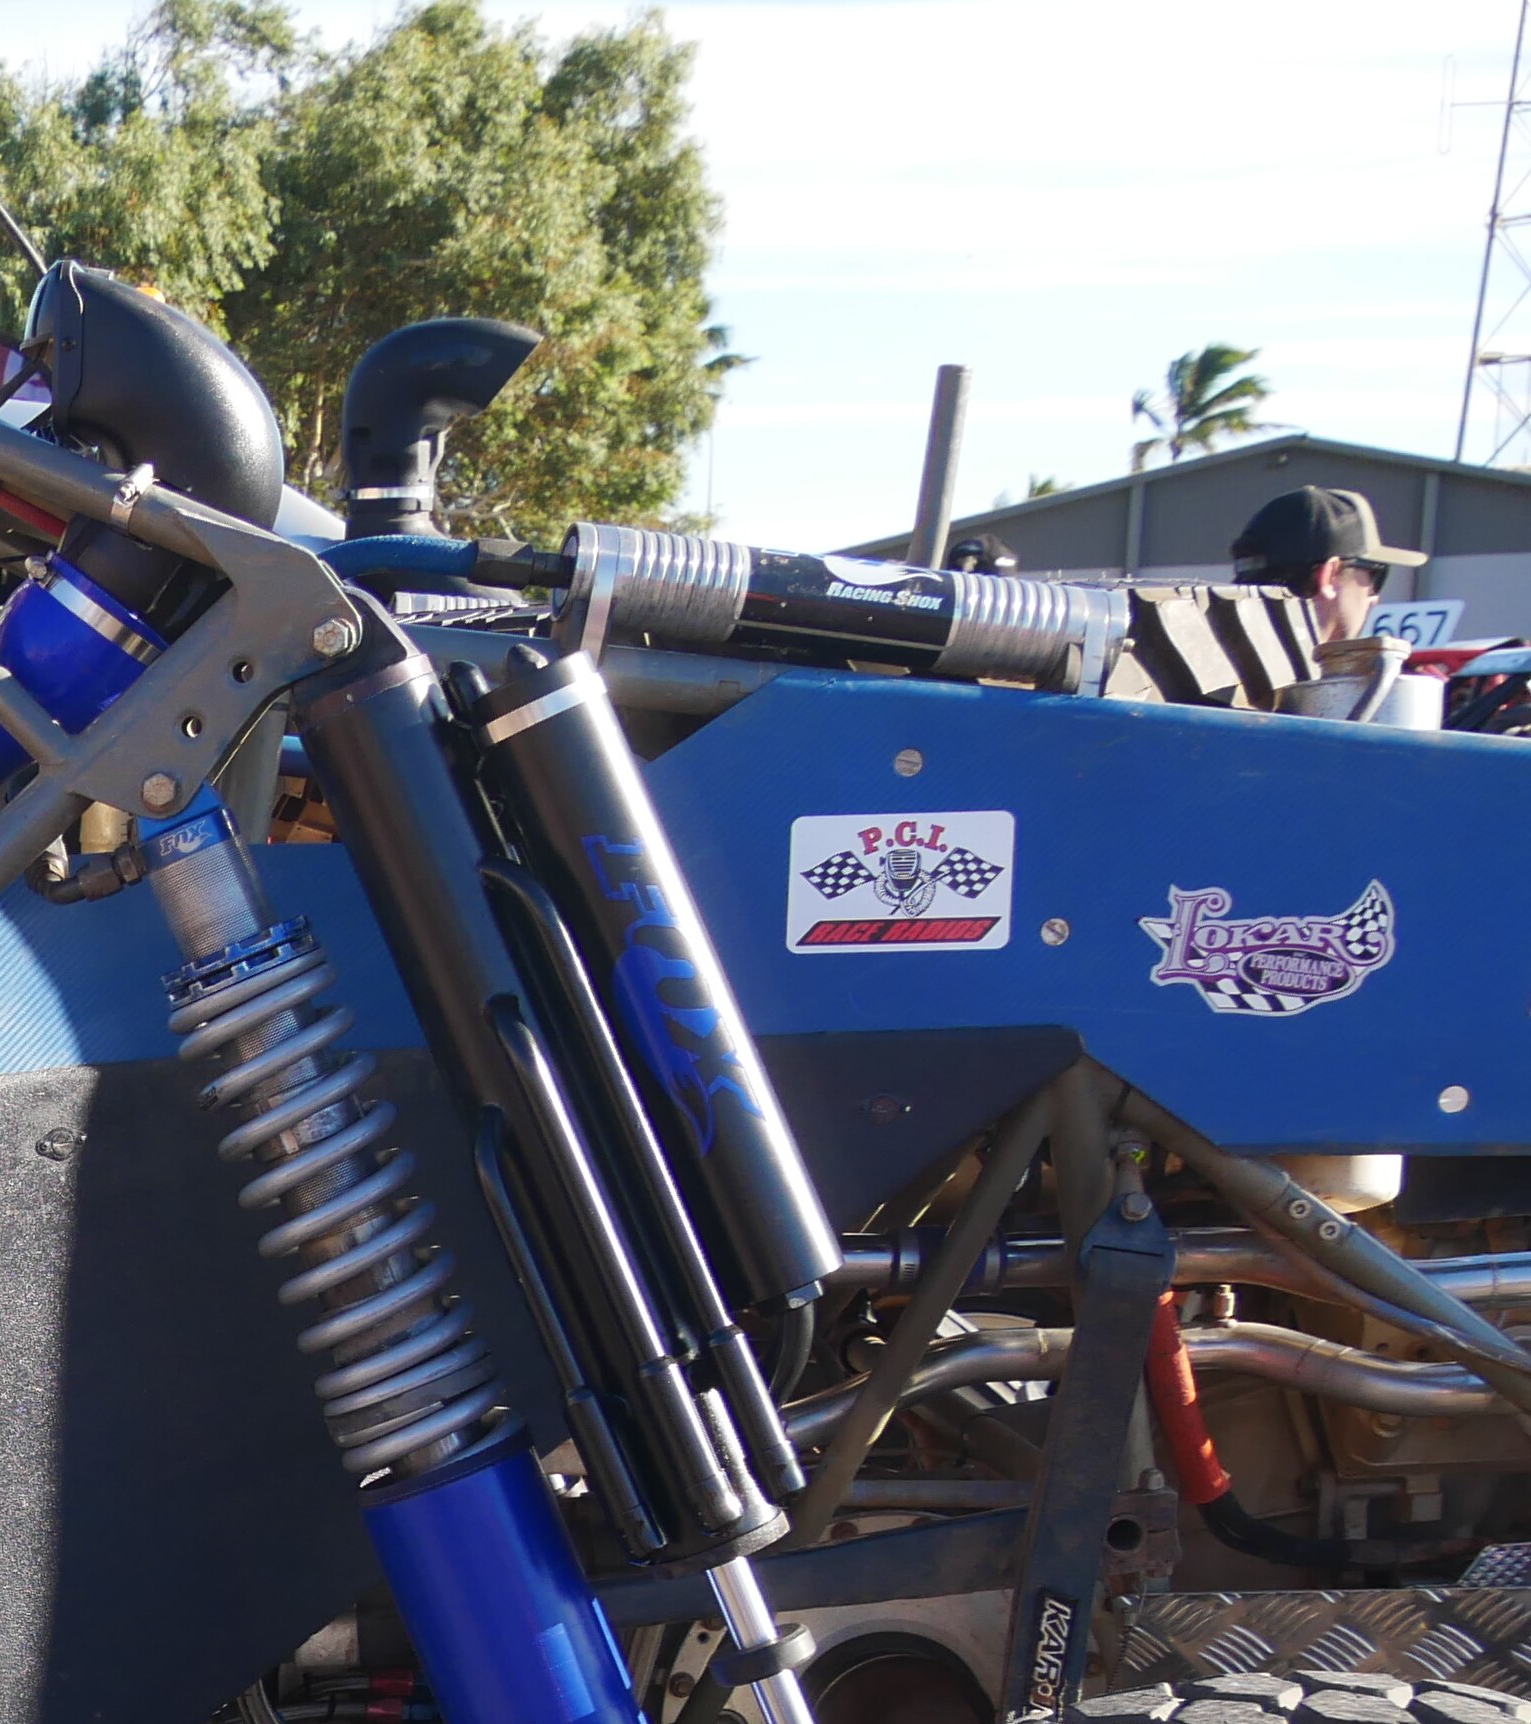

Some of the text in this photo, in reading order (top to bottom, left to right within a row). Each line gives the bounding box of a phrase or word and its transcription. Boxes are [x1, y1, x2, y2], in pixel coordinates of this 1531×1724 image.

[1372, 610, 1448, 647] 667
[160, 819, 212, 857] FOX
[857, 821, 948, 856] P.C.I.
[805, 919, 992, 942] RACE RADIOS
[1156, 890, 1379, 977] LOKAR
[1250, 953, 1345, 978] PERFORMANCE
[1261, 969, 1329, 992] PRODUCTS
